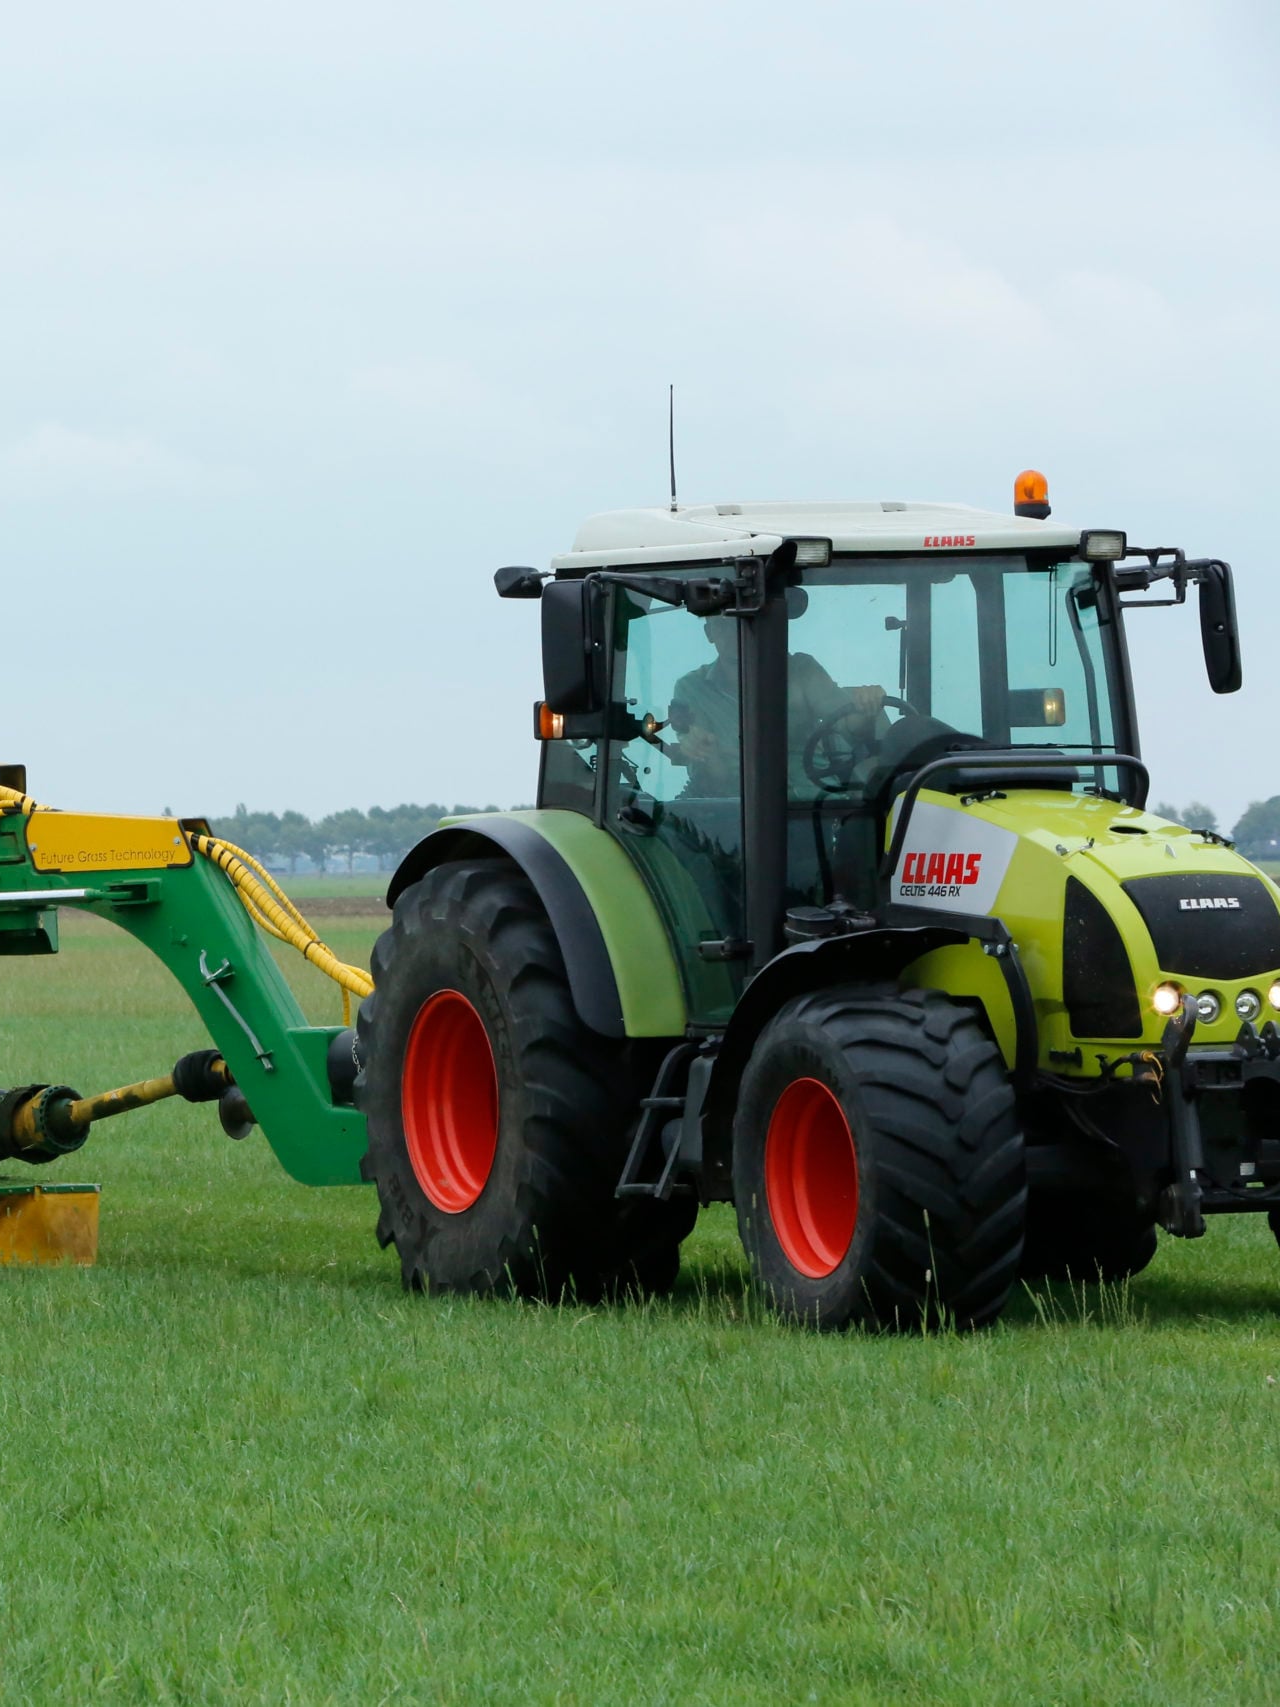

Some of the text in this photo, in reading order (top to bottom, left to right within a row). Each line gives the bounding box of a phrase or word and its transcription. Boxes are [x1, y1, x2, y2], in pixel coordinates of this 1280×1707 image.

[923, 535, 976, 547] CLAAS
[40, 849, 176, 865] Future Grass Technology
[901, 852, 982, 884] CLAAS
[900, 885, 961, 897] CELTIS 446 RX
[1179, 897, 1240, 909] CLAAS
